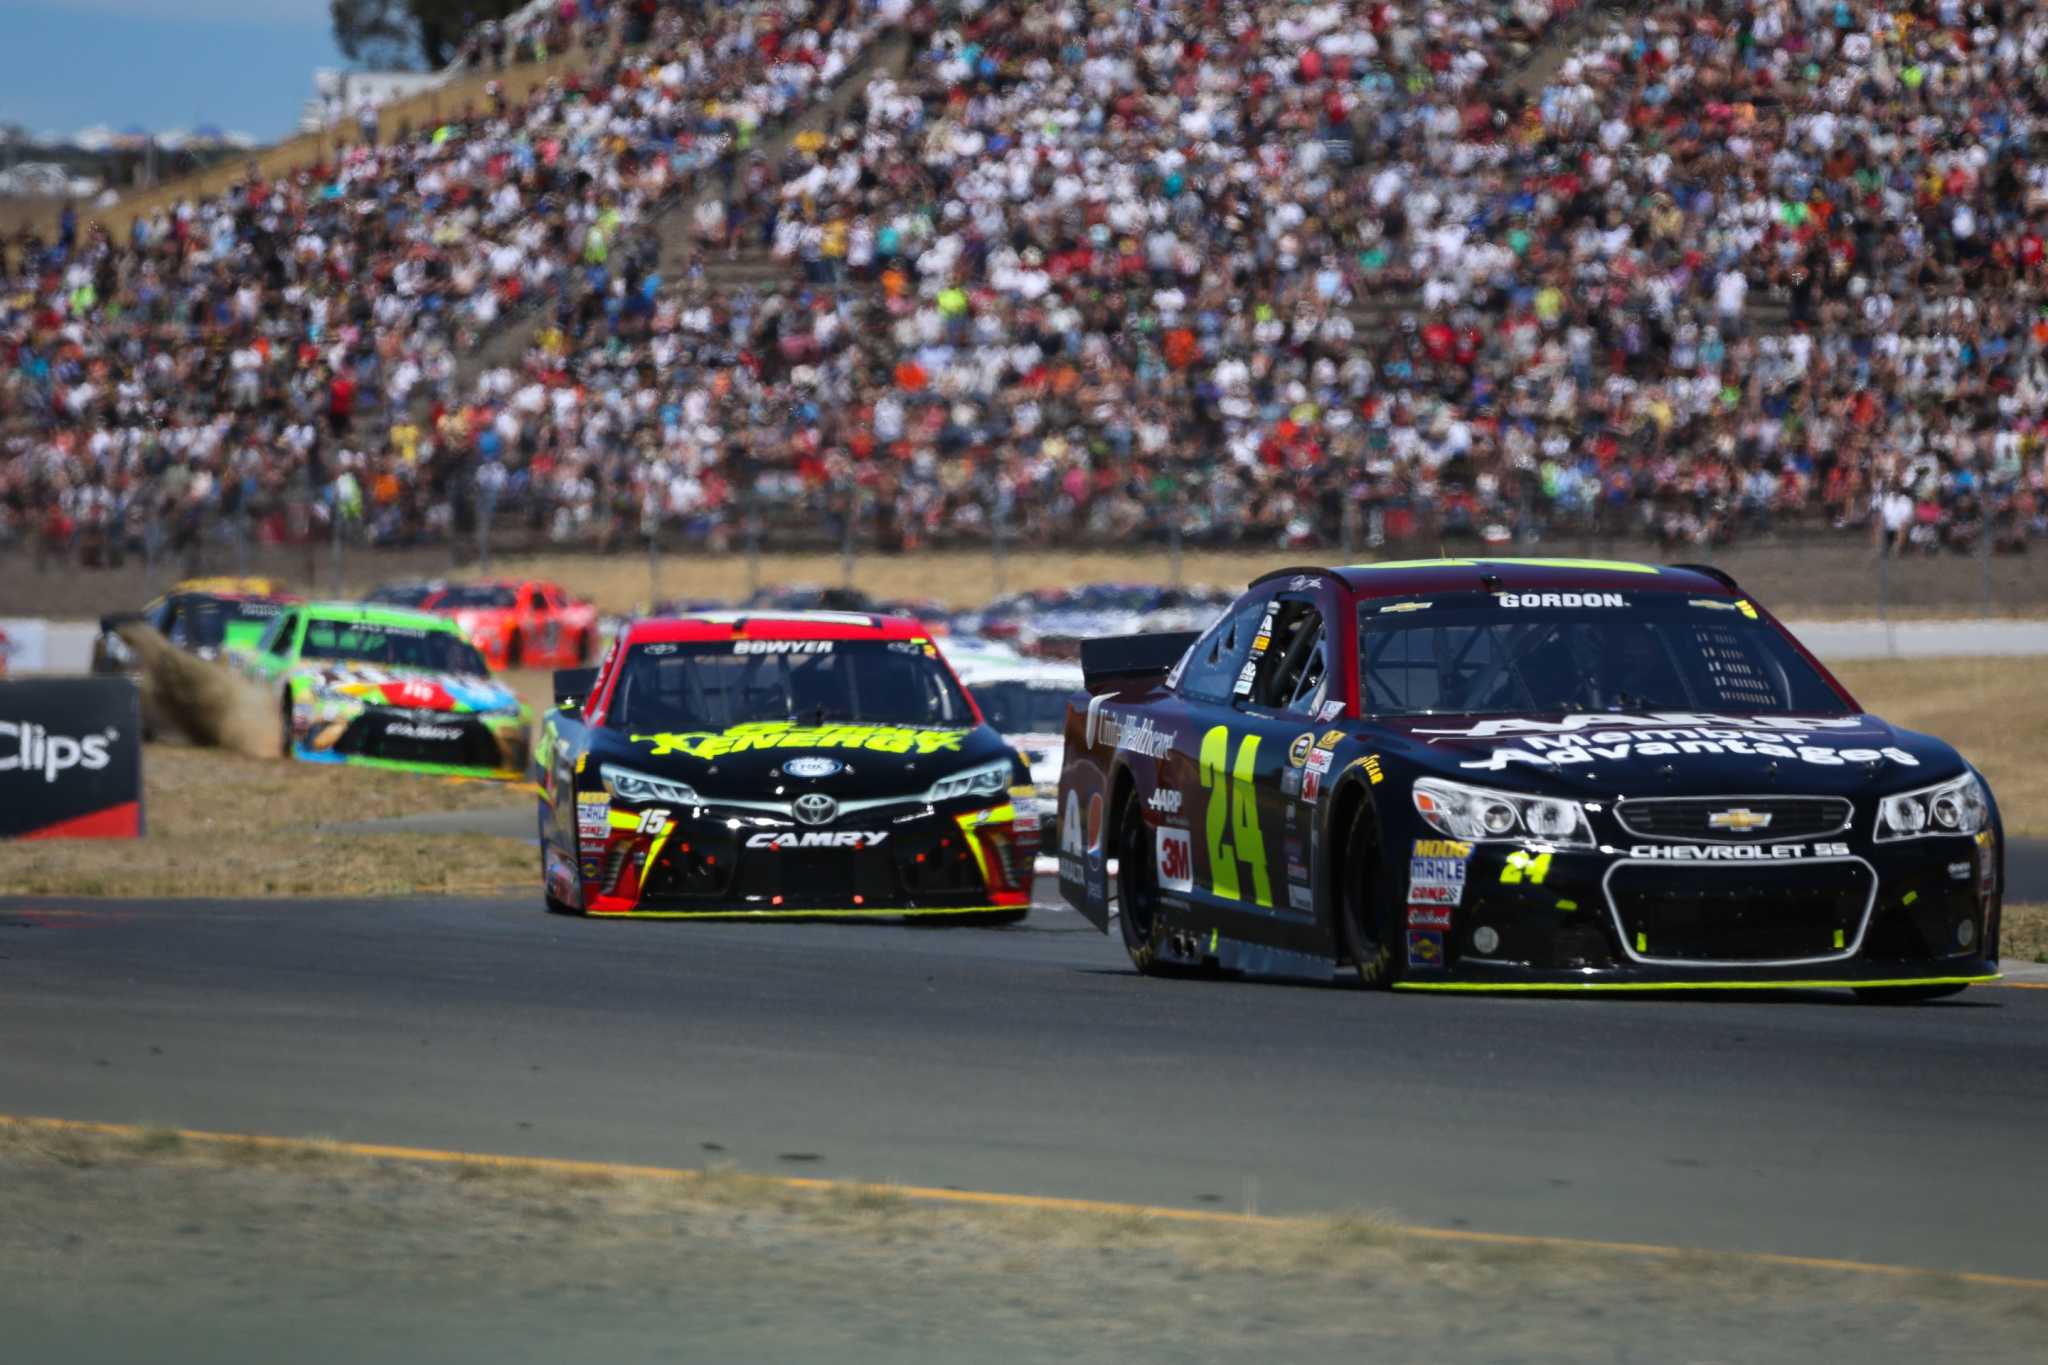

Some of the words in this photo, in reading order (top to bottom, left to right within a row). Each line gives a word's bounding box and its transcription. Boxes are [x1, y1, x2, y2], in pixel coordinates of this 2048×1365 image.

[1499, 593, 1624, 608] GORDON
[733, 641, 833, 655] BOWYER
[1410, 712, 1862, 737] AARP
[1521, 727, 1810, 750] Member
[1459, 739, 1921, 771] Advantages
[1148, 788, 1183, 814] AARP
[637, 808, 672, 834] 15
[1200, 725, 1273, 908] 24
[745, 830, 889, 848] CAMRY
[1630, 844, 1806, 860] CHEVROLET
[1814, 843, 1850, 856] SS
[1161, 838, 1191, 881] 3M
[1500, 850, 1553, 885] 24
